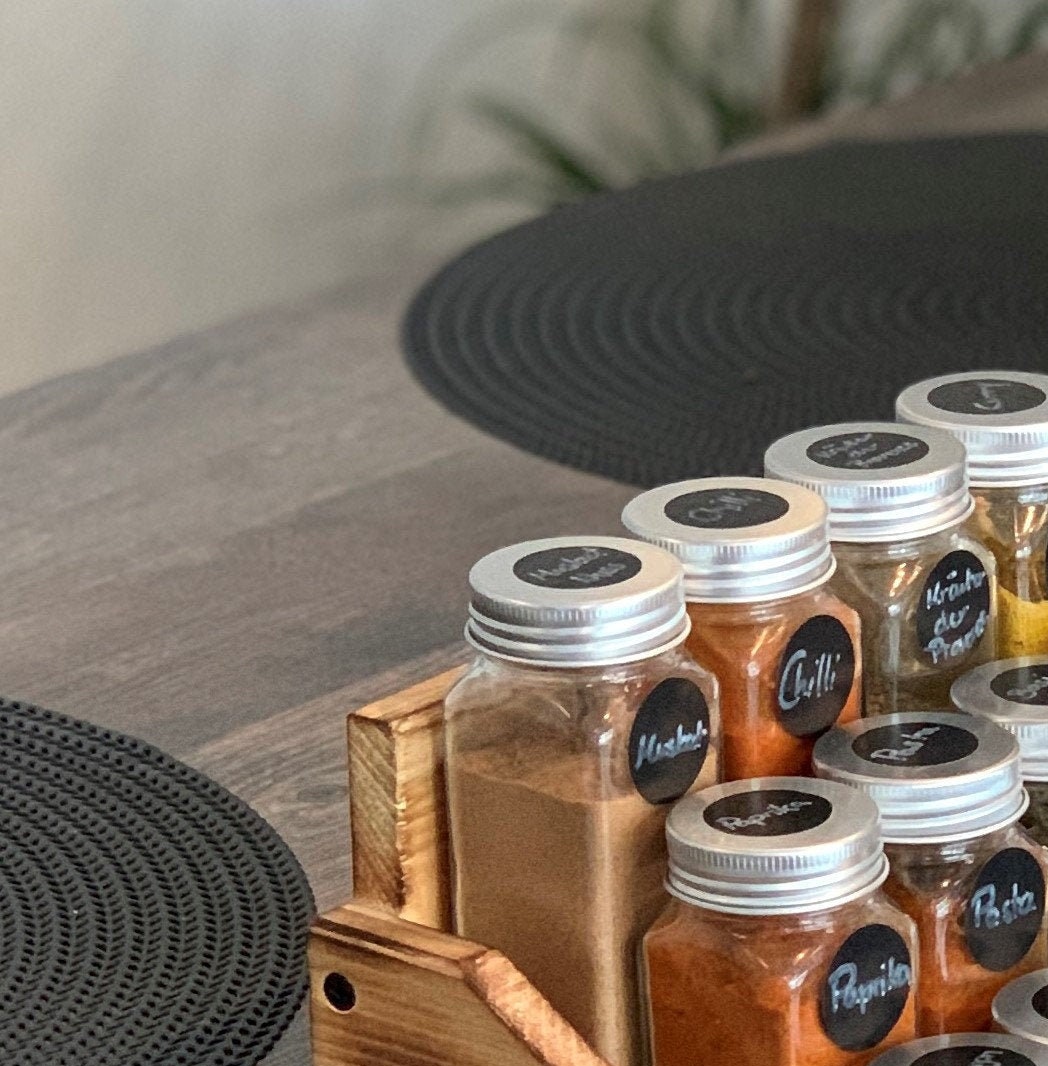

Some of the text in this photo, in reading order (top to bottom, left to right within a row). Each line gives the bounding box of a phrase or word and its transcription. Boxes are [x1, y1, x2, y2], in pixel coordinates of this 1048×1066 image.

[778, 648, 841, 711] Chilli
[970, 882, 1037, 930] Pasta
[828, 956, 911, 1015] Paprika
